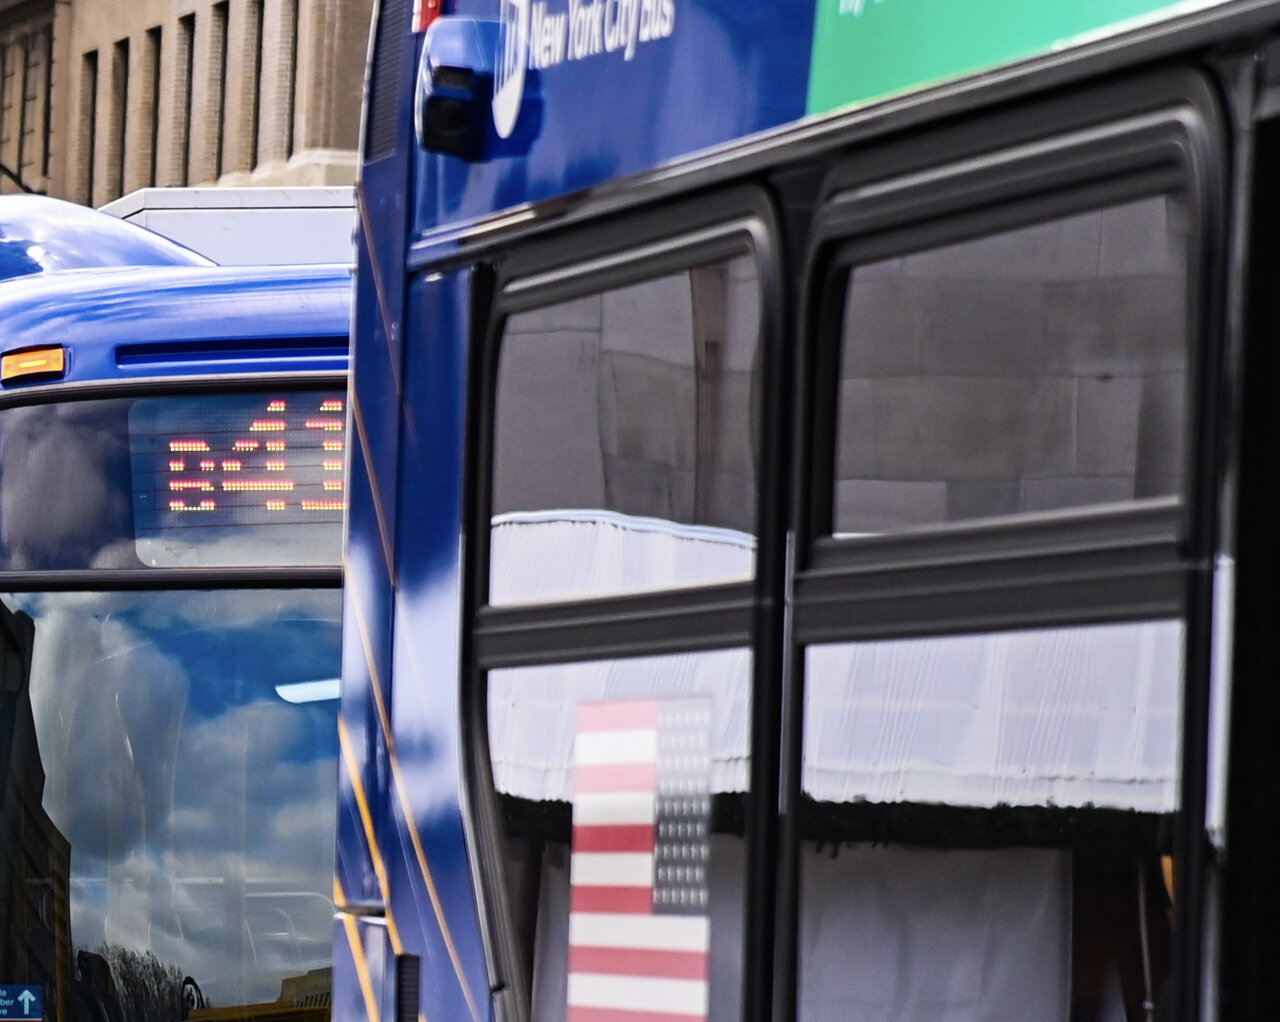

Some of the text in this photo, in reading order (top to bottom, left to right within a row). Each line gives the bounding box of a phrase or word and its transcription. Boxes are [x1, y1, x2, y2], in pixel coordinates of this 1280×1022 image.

[529, 0, 675, 70] New York City Bus
